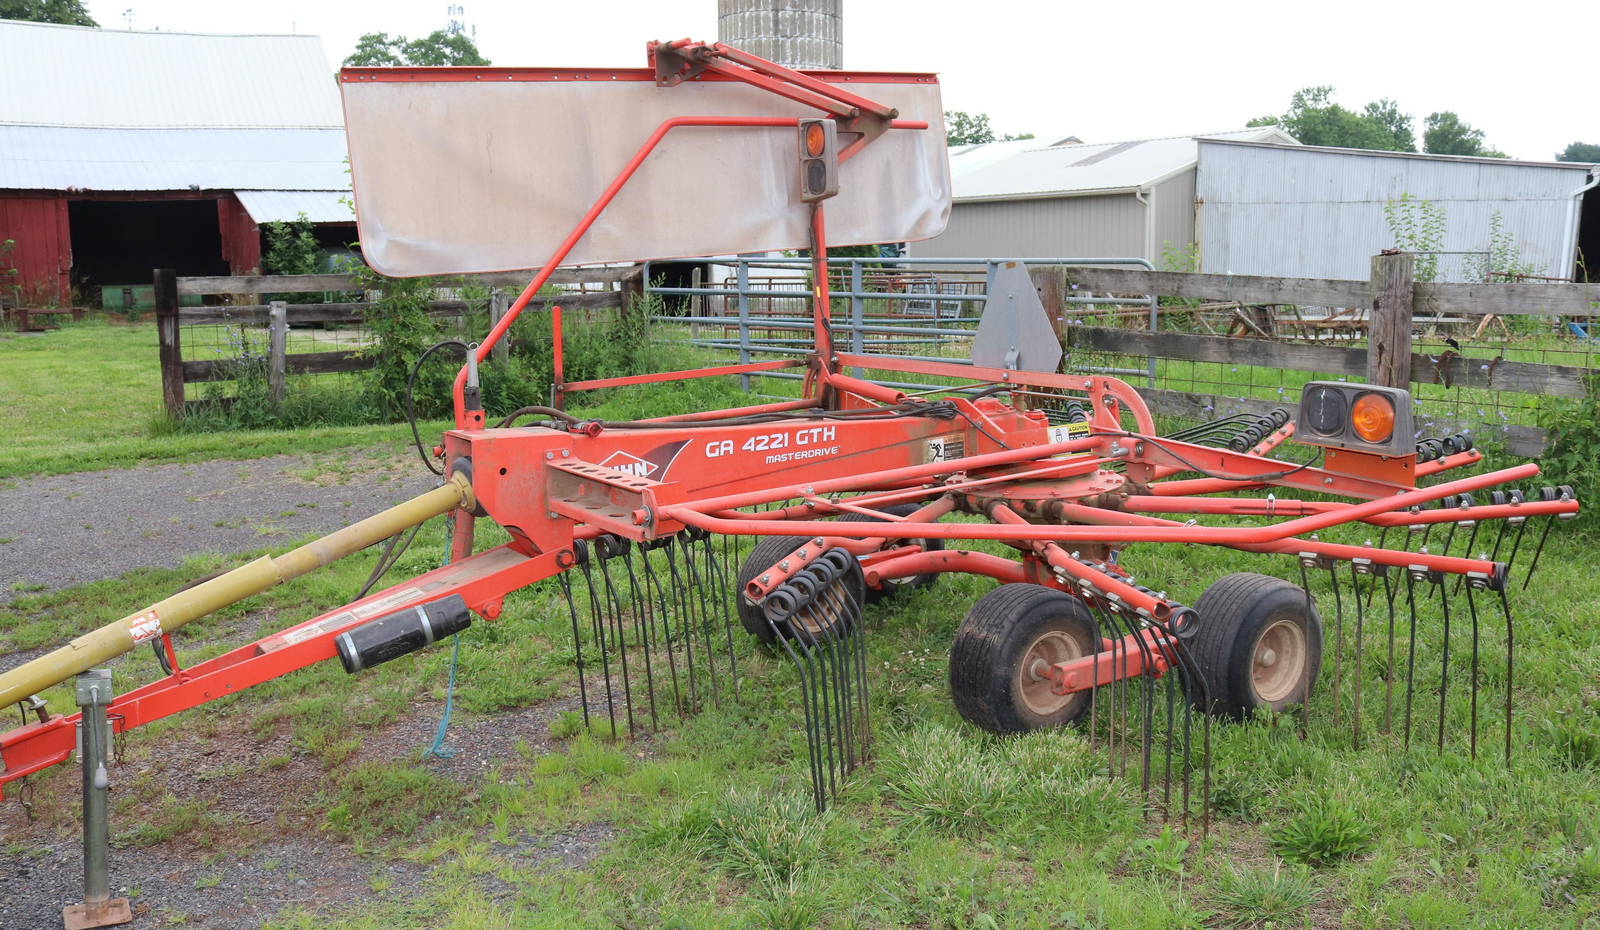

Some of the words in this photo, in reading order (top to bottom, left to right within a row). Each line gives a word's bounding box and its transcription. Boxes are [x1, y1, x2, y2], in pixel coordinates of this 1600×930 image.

[706, 440, 734, 458] GA
[742, 432, 789, 452] 4221
[795, 426, 836, 445] GTH
[765, 447, 838, 464] MASTERDRIVE
